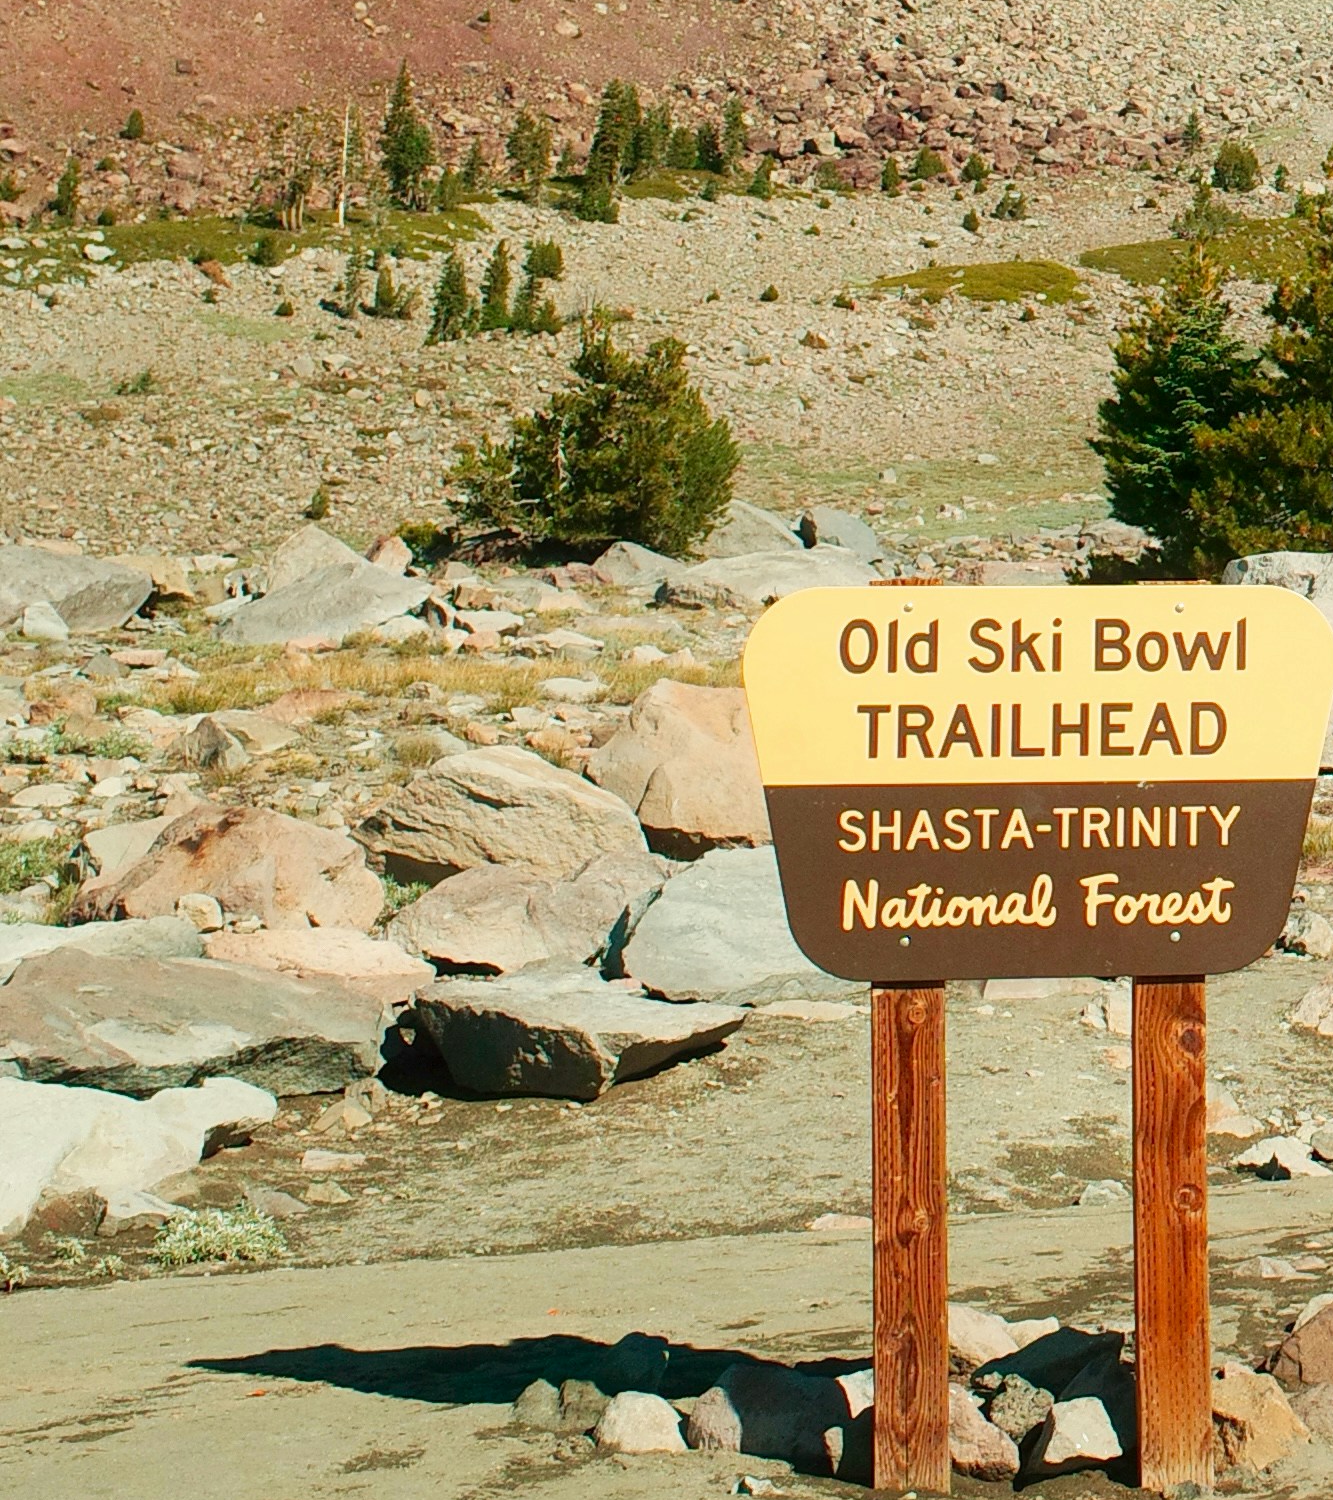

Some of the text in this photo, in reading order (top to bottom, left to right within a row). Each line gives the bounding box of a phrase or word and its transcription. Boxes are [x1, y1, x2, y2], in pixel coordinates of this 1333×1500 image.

[838, 616, 1248, 675] Old Ski Bowl
[857, 701, 1228, 760] TRAILHEAD
[837, 805, 1242, 853] SHASTA-TRINITY
[841, 873, 1235, 932] National Forest
